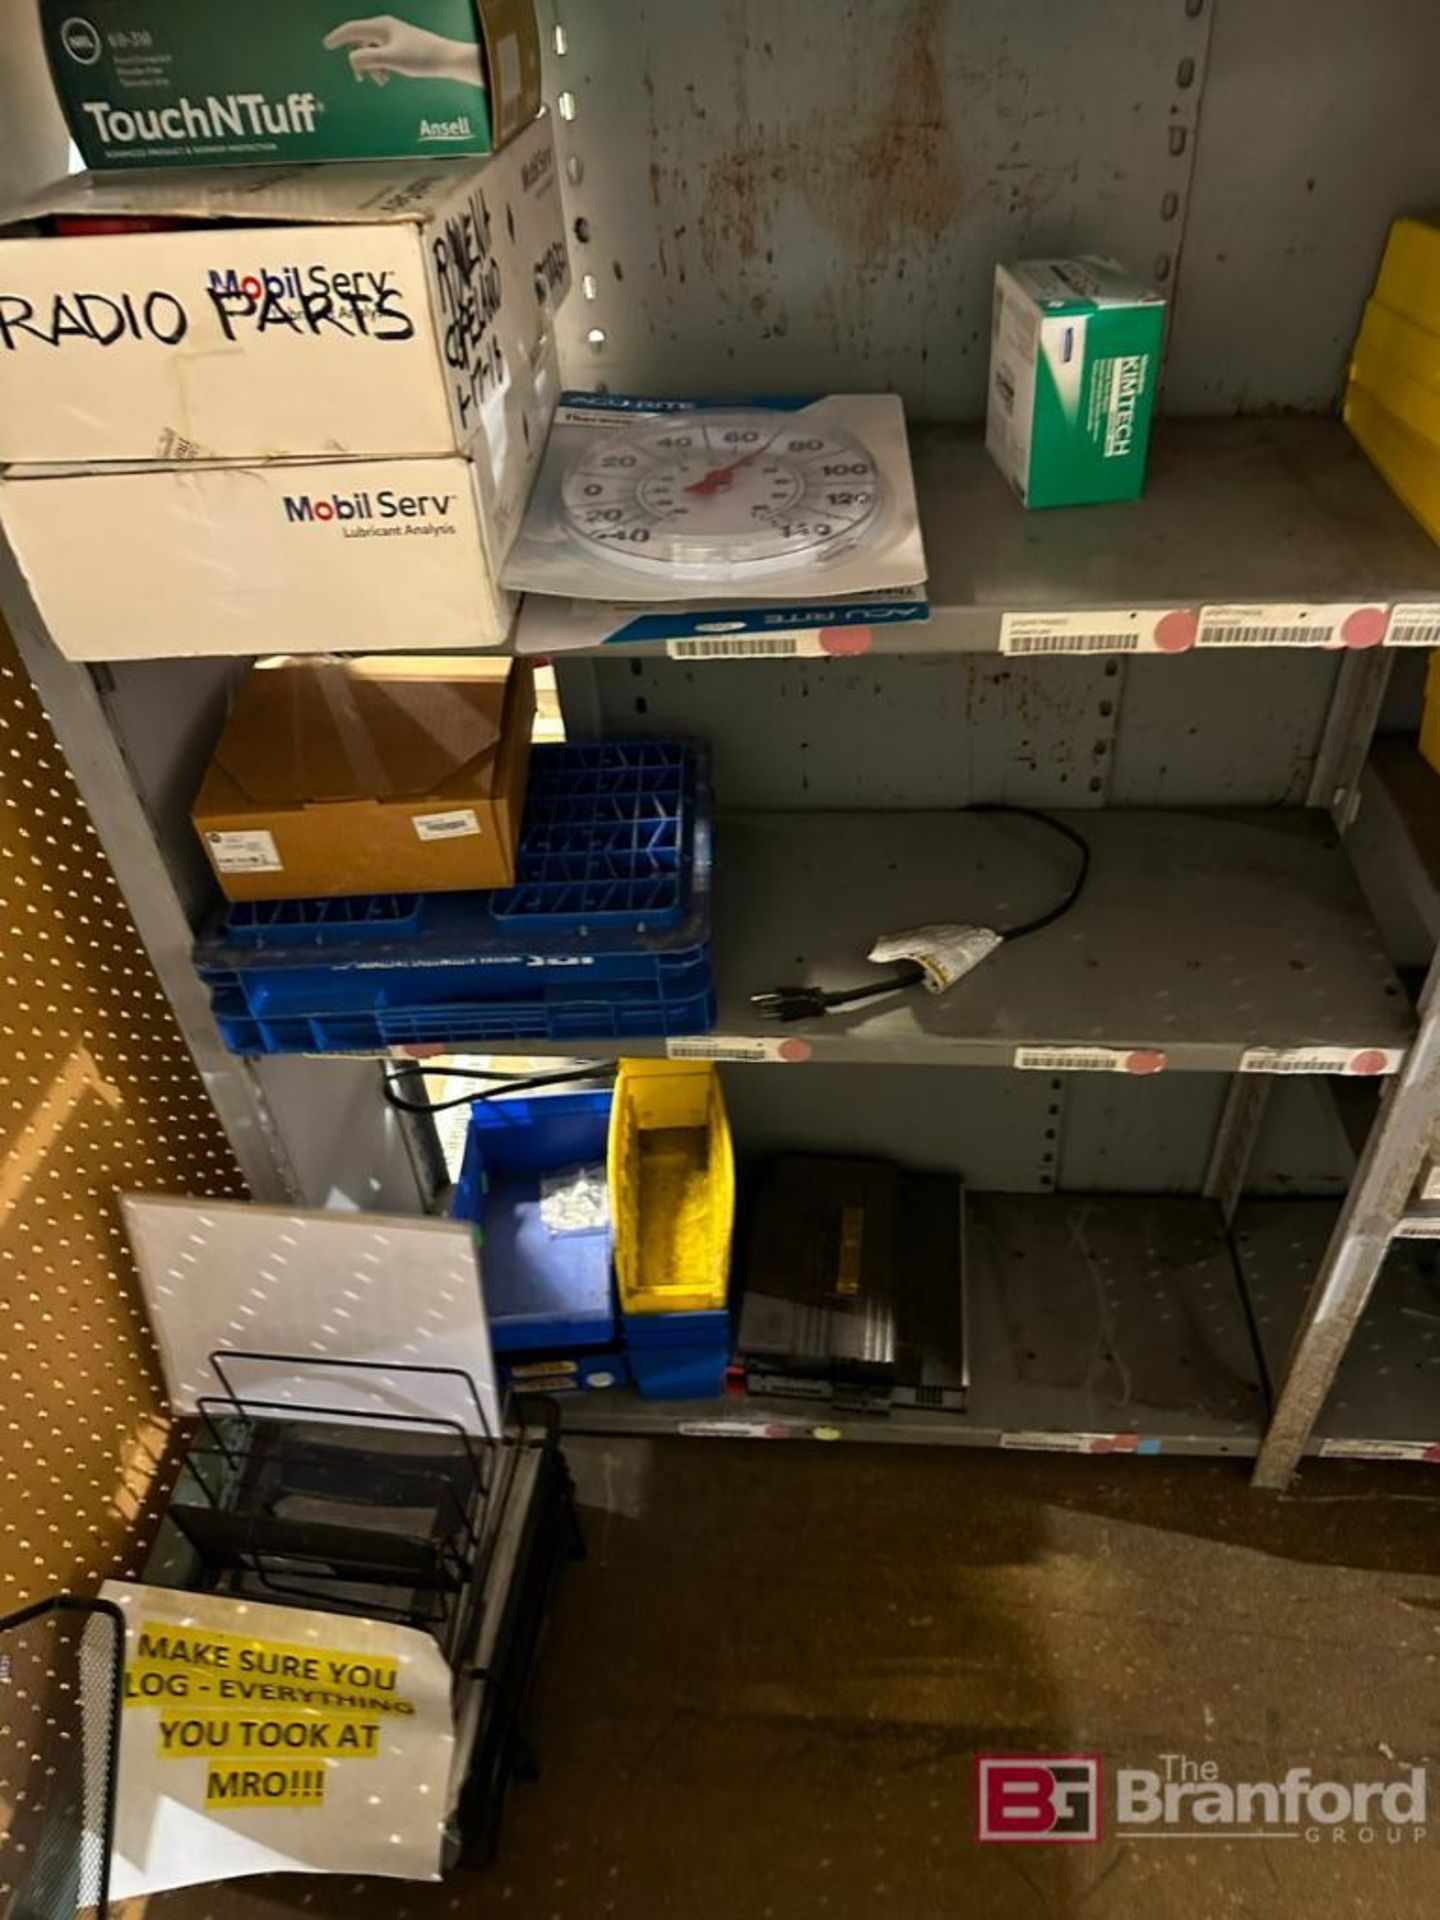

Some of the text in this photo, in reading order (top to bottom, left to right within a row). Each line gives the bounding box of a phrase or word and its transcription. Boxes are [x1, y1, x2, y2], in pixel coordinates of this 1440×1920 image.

[83, 92, 316, 143] TouchNTuff
[420, 118, 471, 137] Ansell
[0, 287, 414, 349] RADIO PARTS
[1112, 355, 1141, 457] KIMTECH
[657, 436, 693, 448] 40
[724, 431, 759, 443] 60
[788, 439, 825, 451] 80
[602, 454, 638, 468] 20
[822, 463, 869, 477] 100
[584, 483, 603, 497] 0
[282, 490, 450, 522] Mobil Serv
[343, 522, 456, 539] Lubricant Analysis
[137, 1633, 397, 1691] MAKE SURE YOU
[124, 1672, 188, 1698] LOG
[220, 1679, 416, 1715] EVERYTHING
[160, 1721, 380, 1749] YOU TOOK AT
[207, 1770, 325, 1799] MRO!!!
